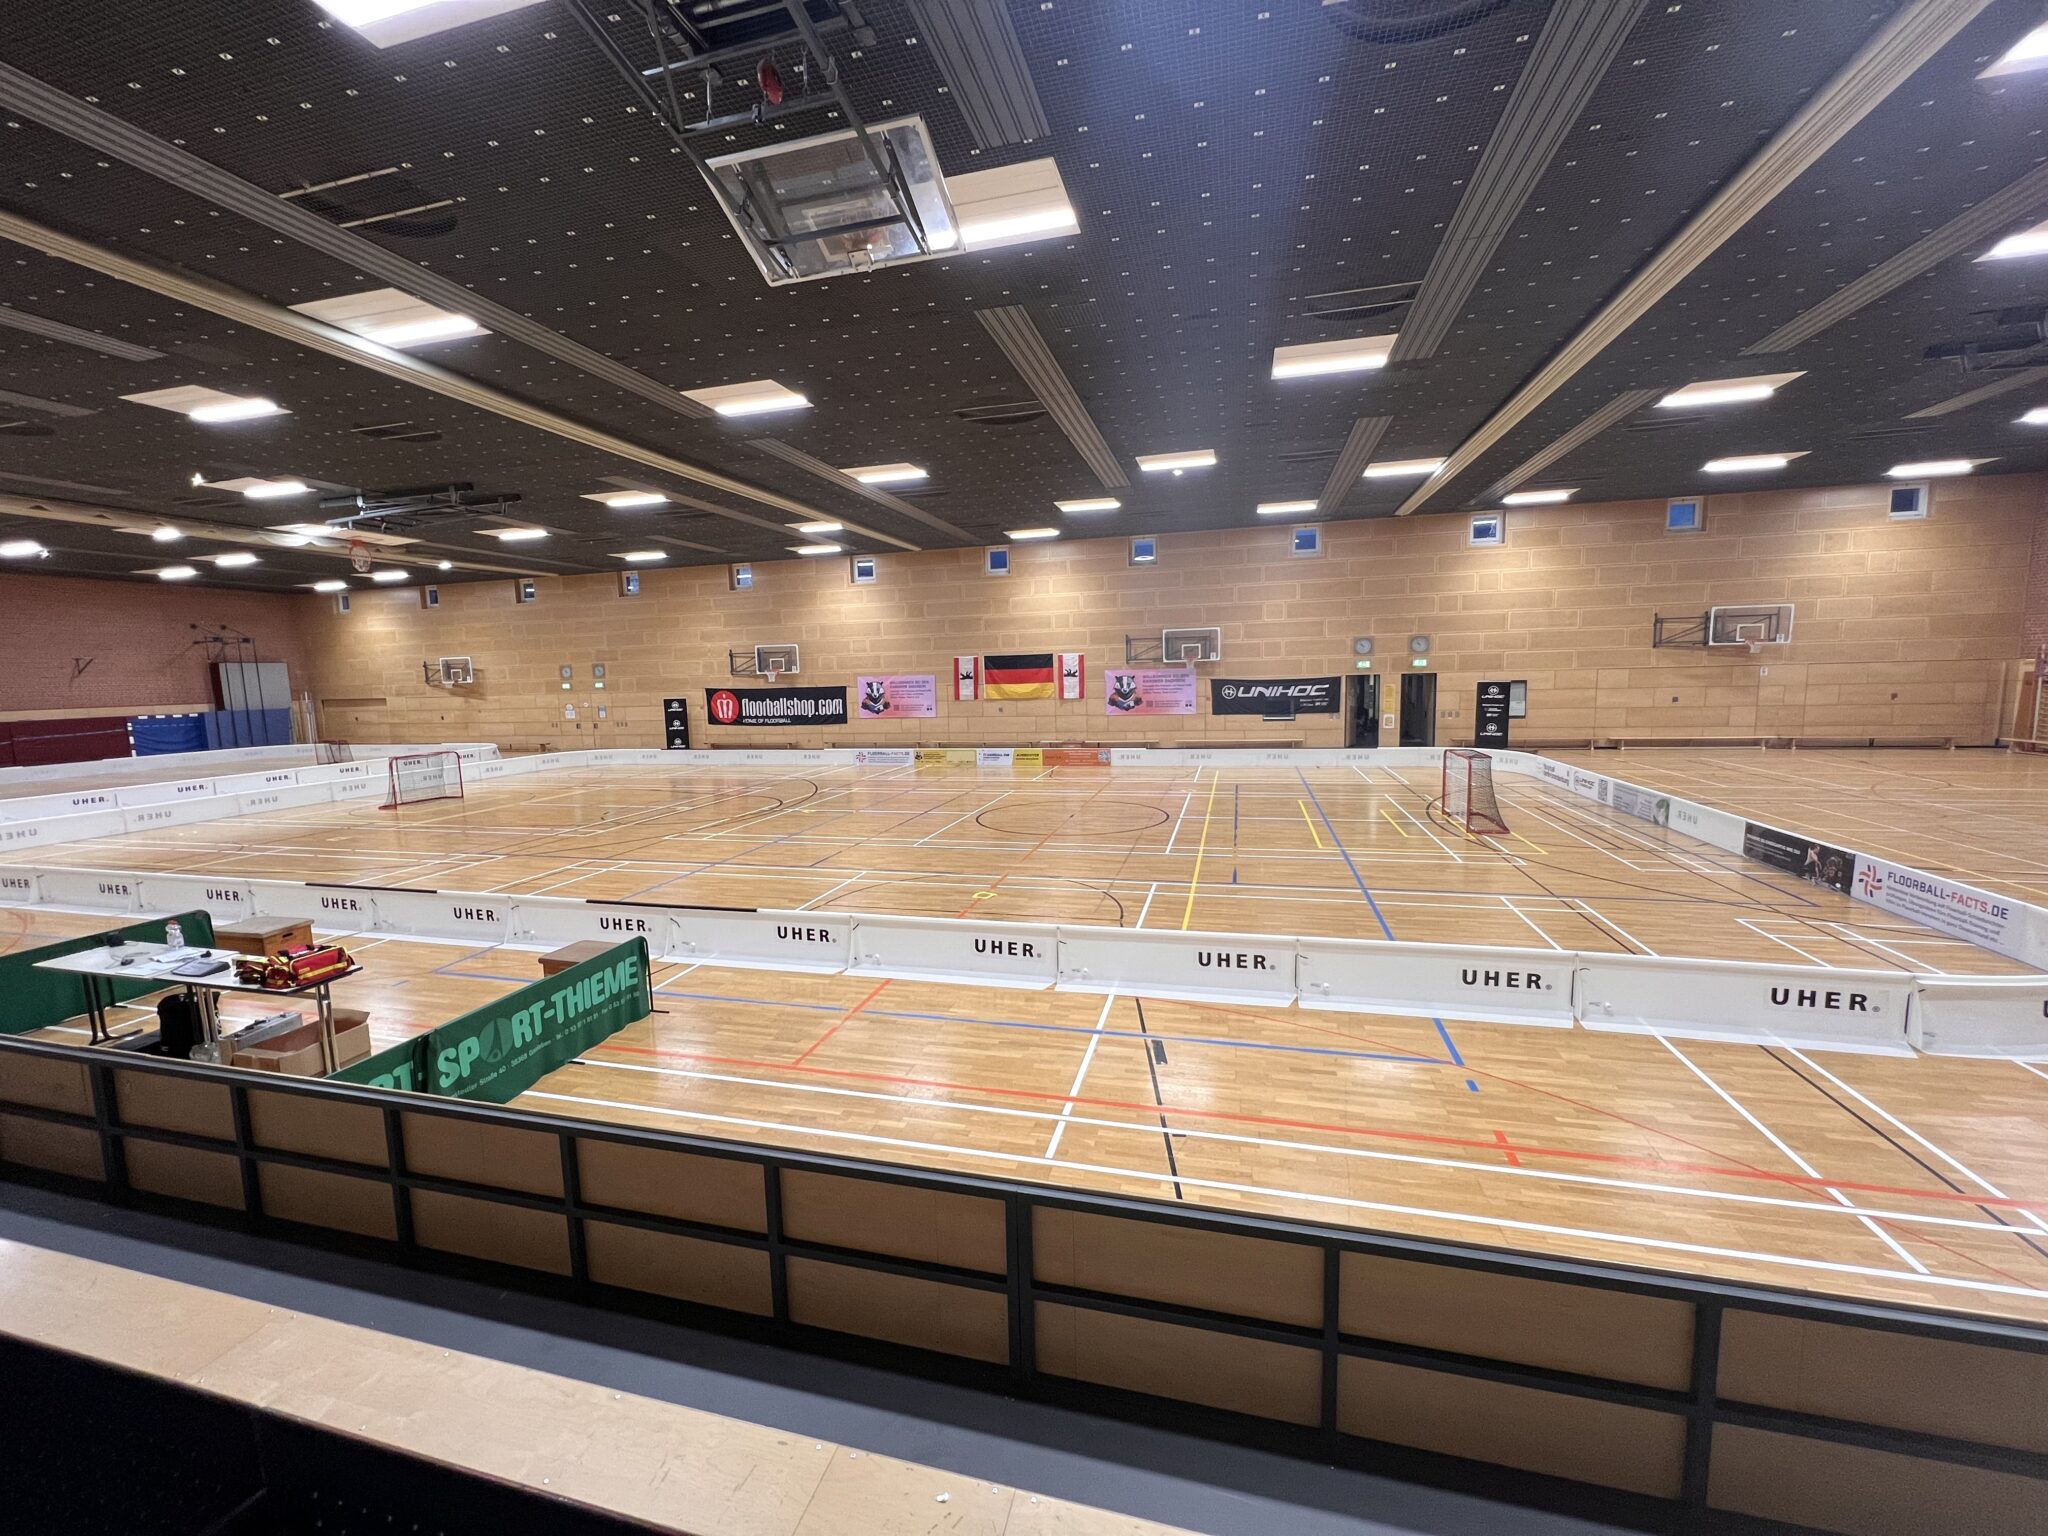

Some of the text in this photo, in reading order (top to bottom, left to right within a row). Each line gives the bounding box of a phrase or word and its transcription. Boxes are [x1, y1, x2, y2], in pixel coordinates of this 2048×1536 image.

[1237, 684, 1330, 698] UNIHOC
[741, 696, 843, 718] floorballshop.com
[1887, 871, 2009, 920] FLOORBALL-FACTS.DE
